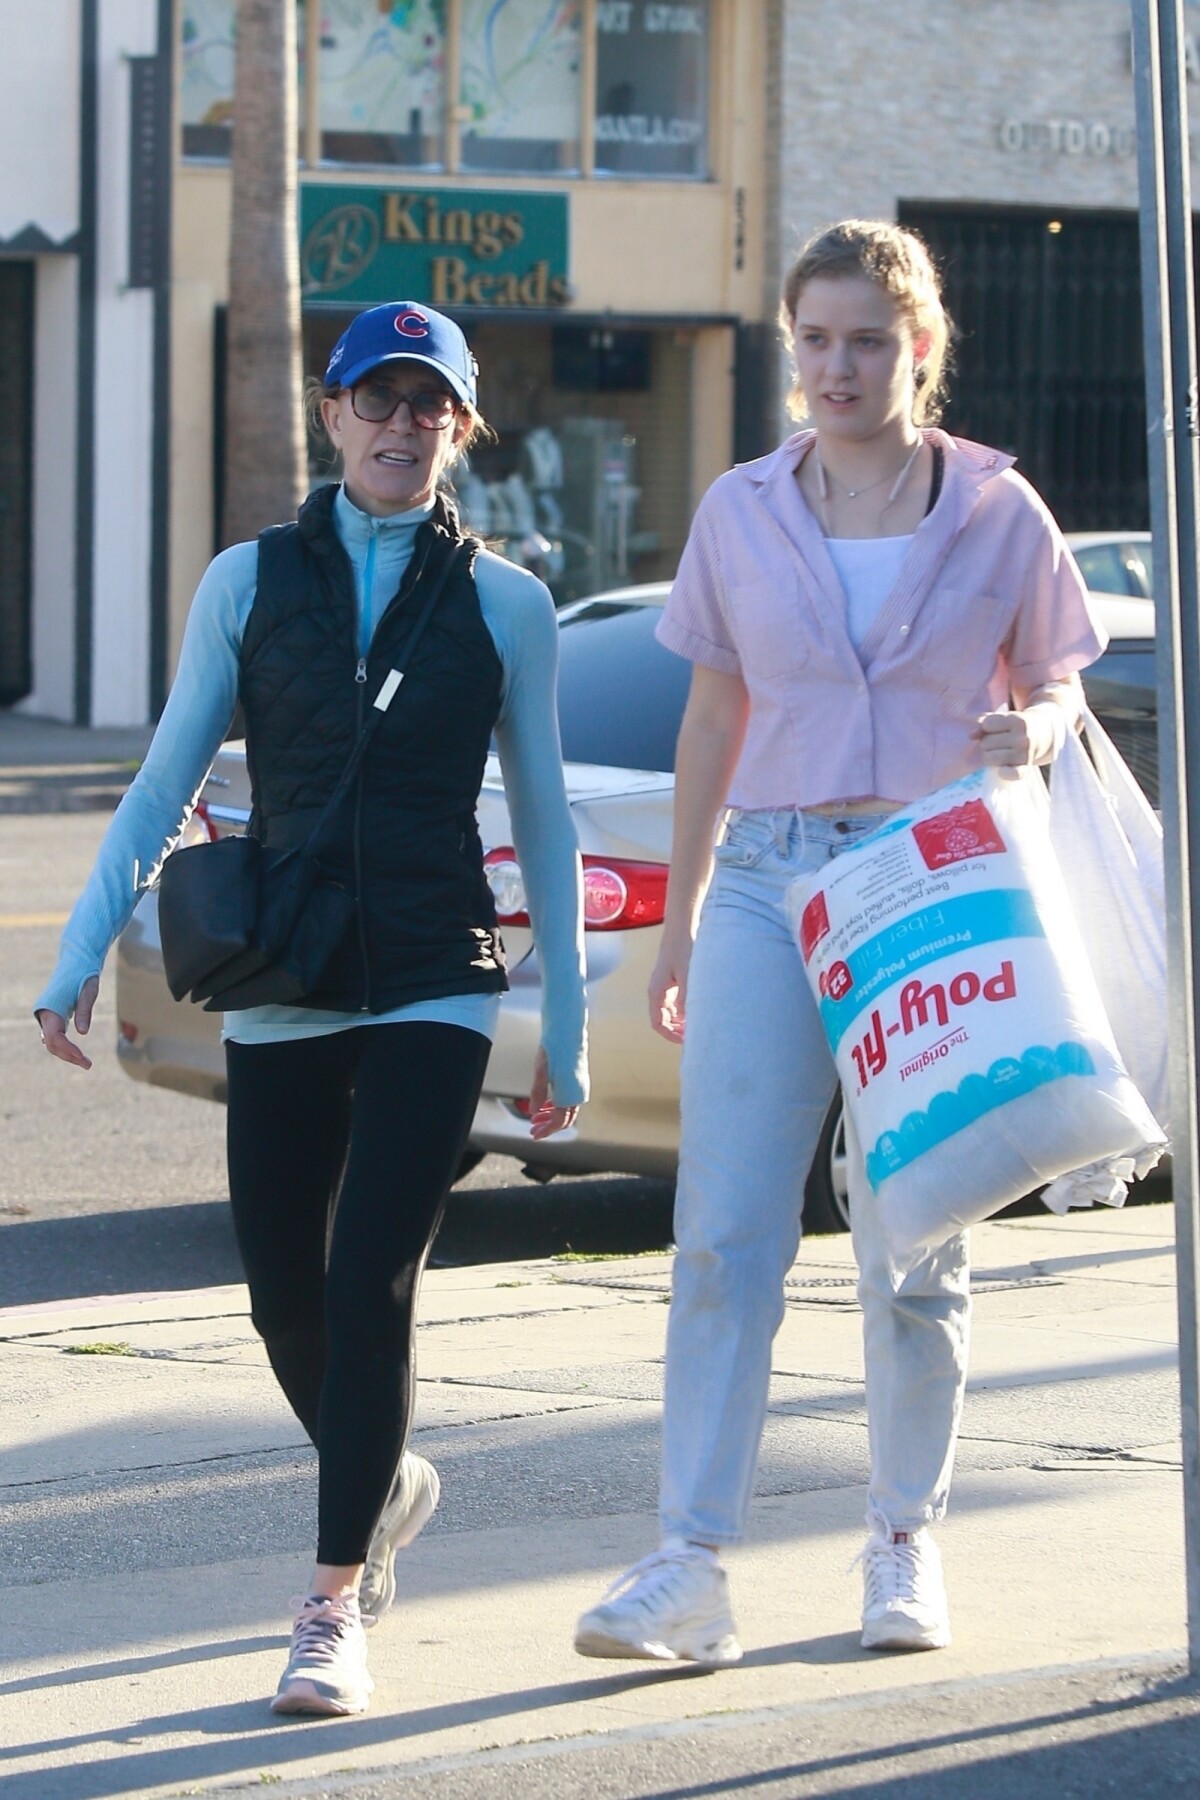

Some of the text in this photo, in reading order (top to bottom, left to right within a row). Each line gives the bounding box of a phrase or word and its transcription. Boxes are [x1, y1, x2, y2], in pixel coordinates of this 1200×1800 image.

[383, 193, 524, 258] Kings
[432, 256, 574, 306] Beads
[394, 310, 428, 338] C
[928, 864, 968, 882] pillows,
[972, 862, 987, 871] for
[898, 878, 927, 897] dolls,
[926, 881, 949, 896] Best
[863, 893, 896, 917] stuffed
[868, 886, 925, 925] performing
[845, 913, 863, 929] toys
[849, 922, 870, 940] fiber
[889, 908, 945, 941] Fiber
[829, 928, 845, 944] and
[852, 929, 972, 1002] Premium Polyester
[828, 969, 850, 994] 32
[898, 1030, 970, 1082] The Original
